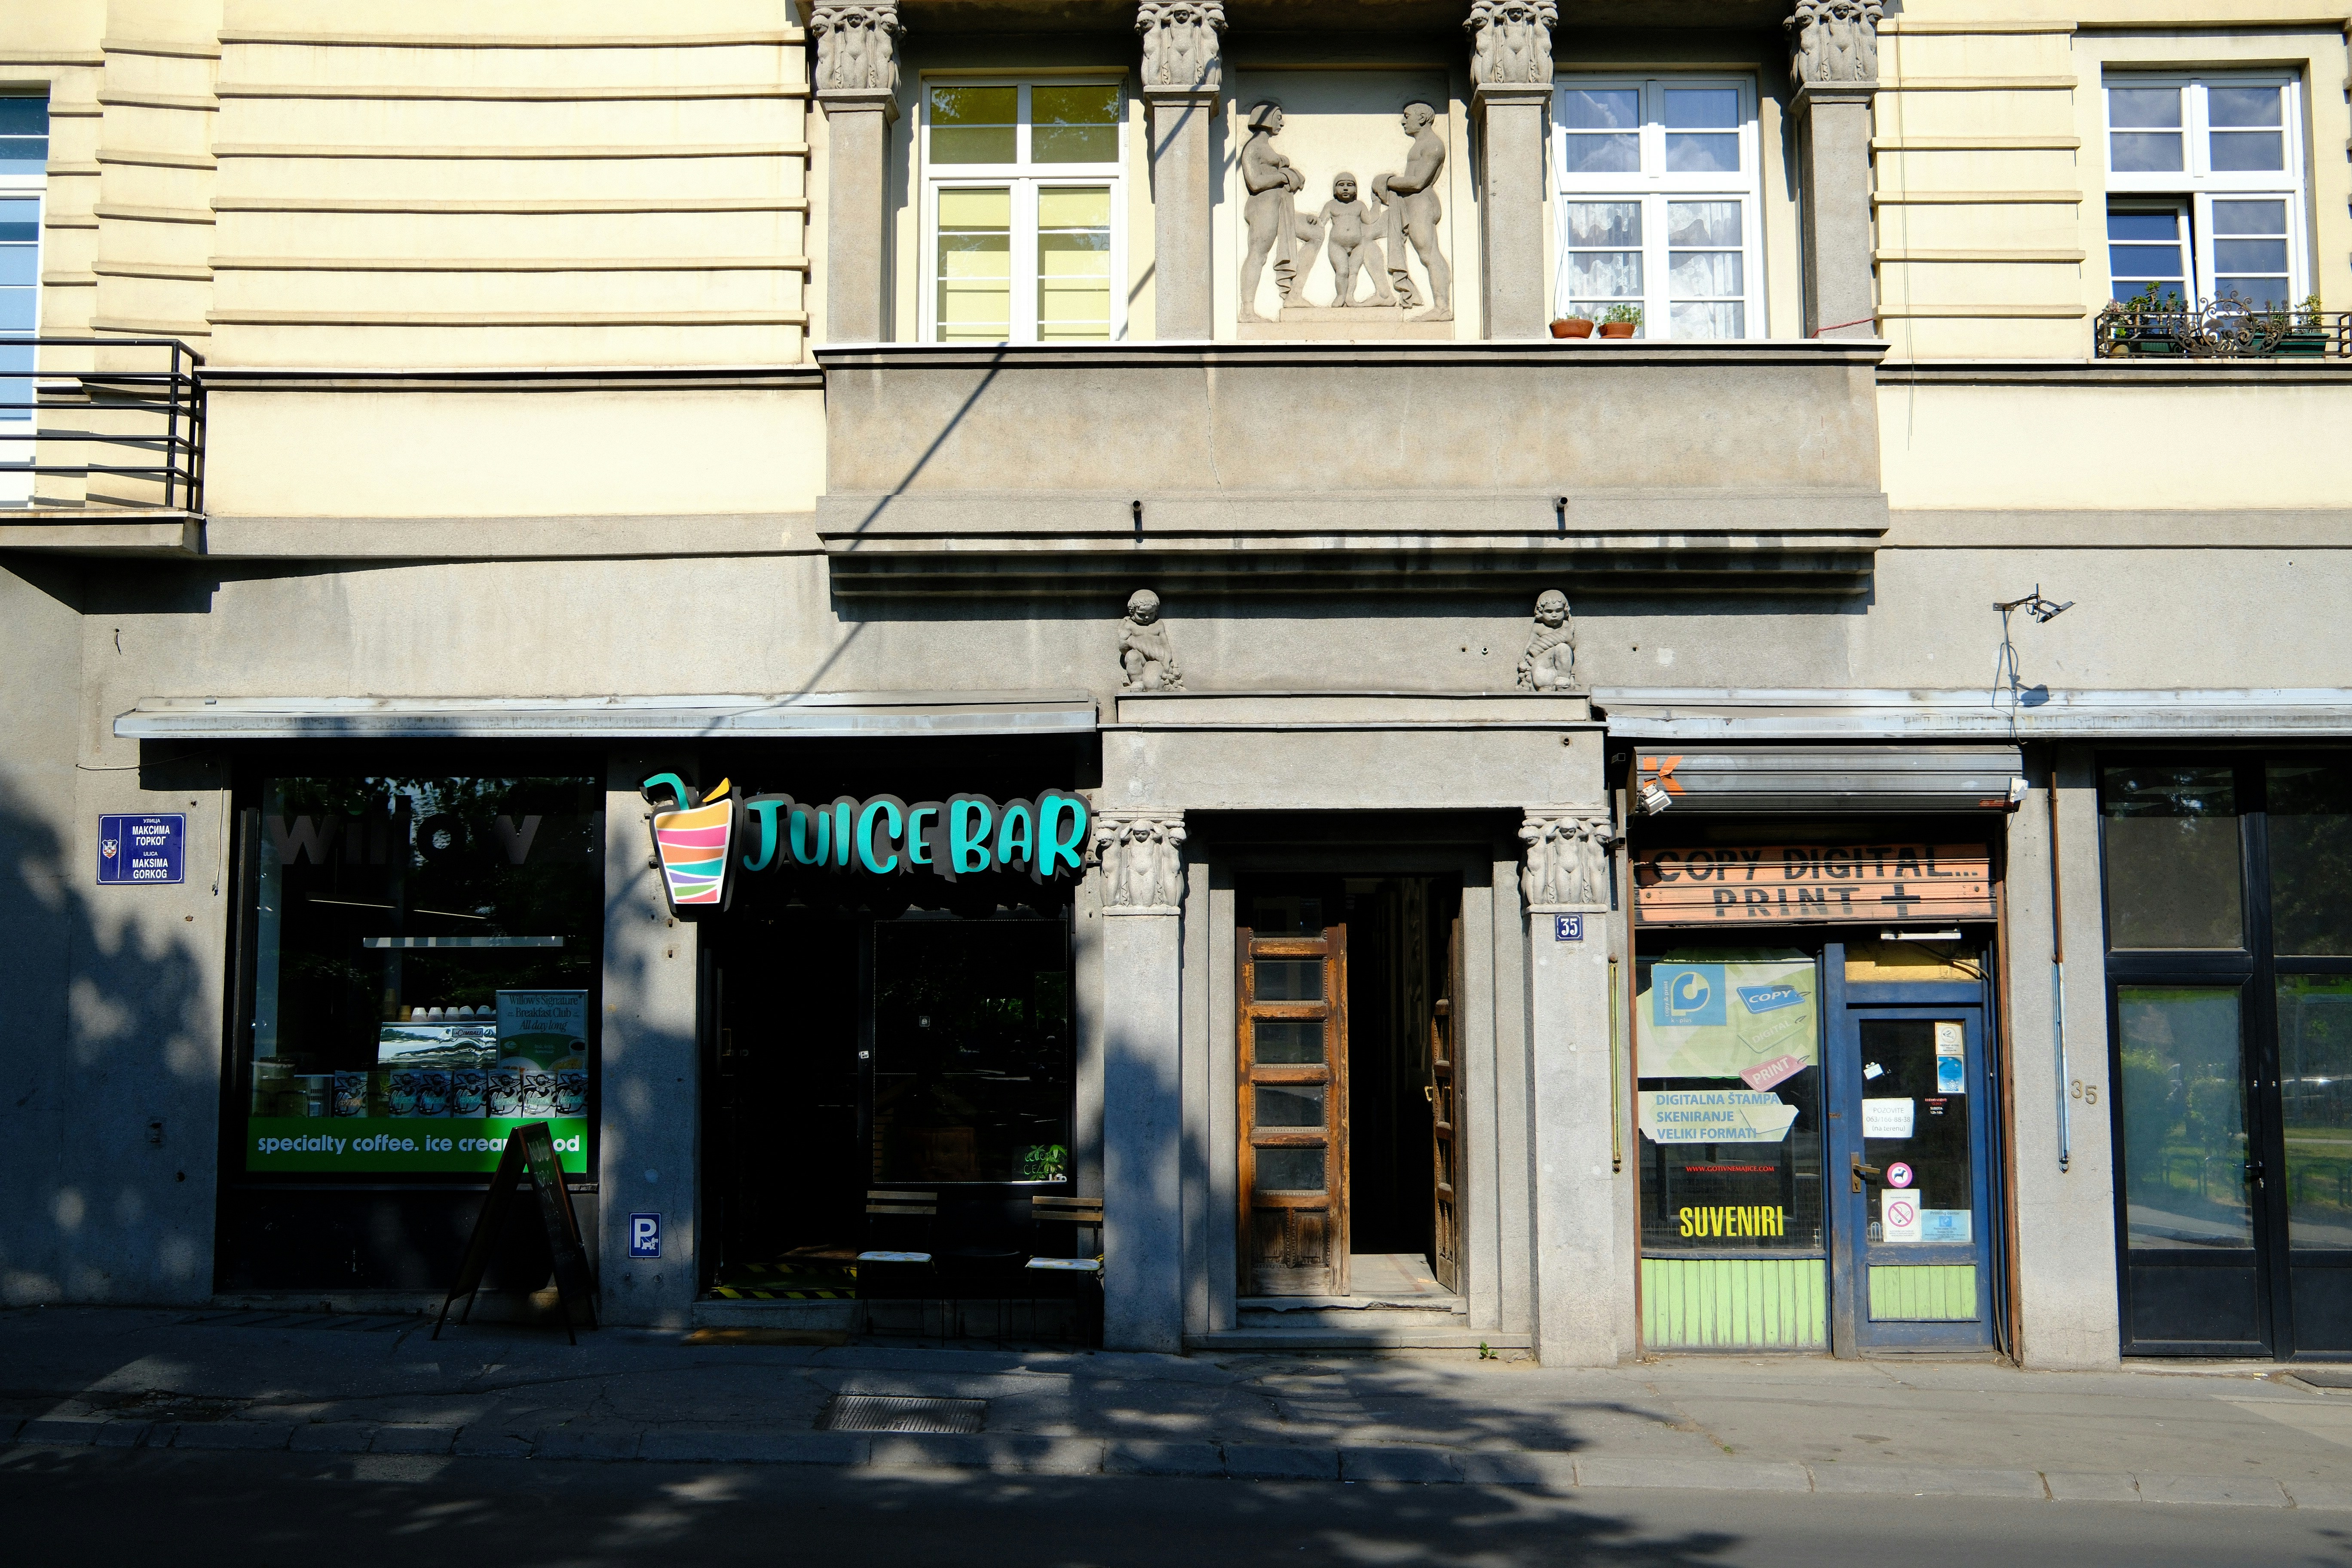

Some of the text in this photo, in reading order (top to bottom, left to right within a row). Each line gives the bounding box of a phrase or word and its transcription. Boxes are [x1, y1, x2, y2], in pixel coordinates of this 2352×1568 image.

[132, 825, 170, 835] МАКСИМА
[743, 795, 1088, 876] JUICE BAR
[136, 836, 166, 845] ГОРКОГ
[132, 858, 168, 868] MAKSIMA
[1654, 850, 1763, 882] COPY
[133, 869, 167, 879] GORKOG
[1712, 887, 1860, 916] PRINT
[1561, 918, 1577, 935] 35
[509, 995, 540, 1005] Willow's
[1749, 990, 1793, 1003] COPY
[516, 1008, 551, 1017] Breakfast
[553, 1008, 571, 1017] Club
[521, 1020, 567, 1032] All day long
[1752, 1020, 1792, 1044] DIGITAL
[1752, 1057, 1789, 1084] PRINT
[1657, 1092, 1779, 1105] DIGITALNA ŠTAMPA
[2071, 1079, 2097, 1105] 35
[1657, 1111, 1734, 1122] SKENIRANJE
[1657, 1128, 1758, 1139] VELIKI FORMATI
[258, 1134, 347, 1155] specialty
[352, 1134, 419, 1152] coffee.
[426, 1135, 453, 1152] ice
[1680, 1206, 1783, 1237] SUVENIRI
[634, 1219, 657, 1248] P
